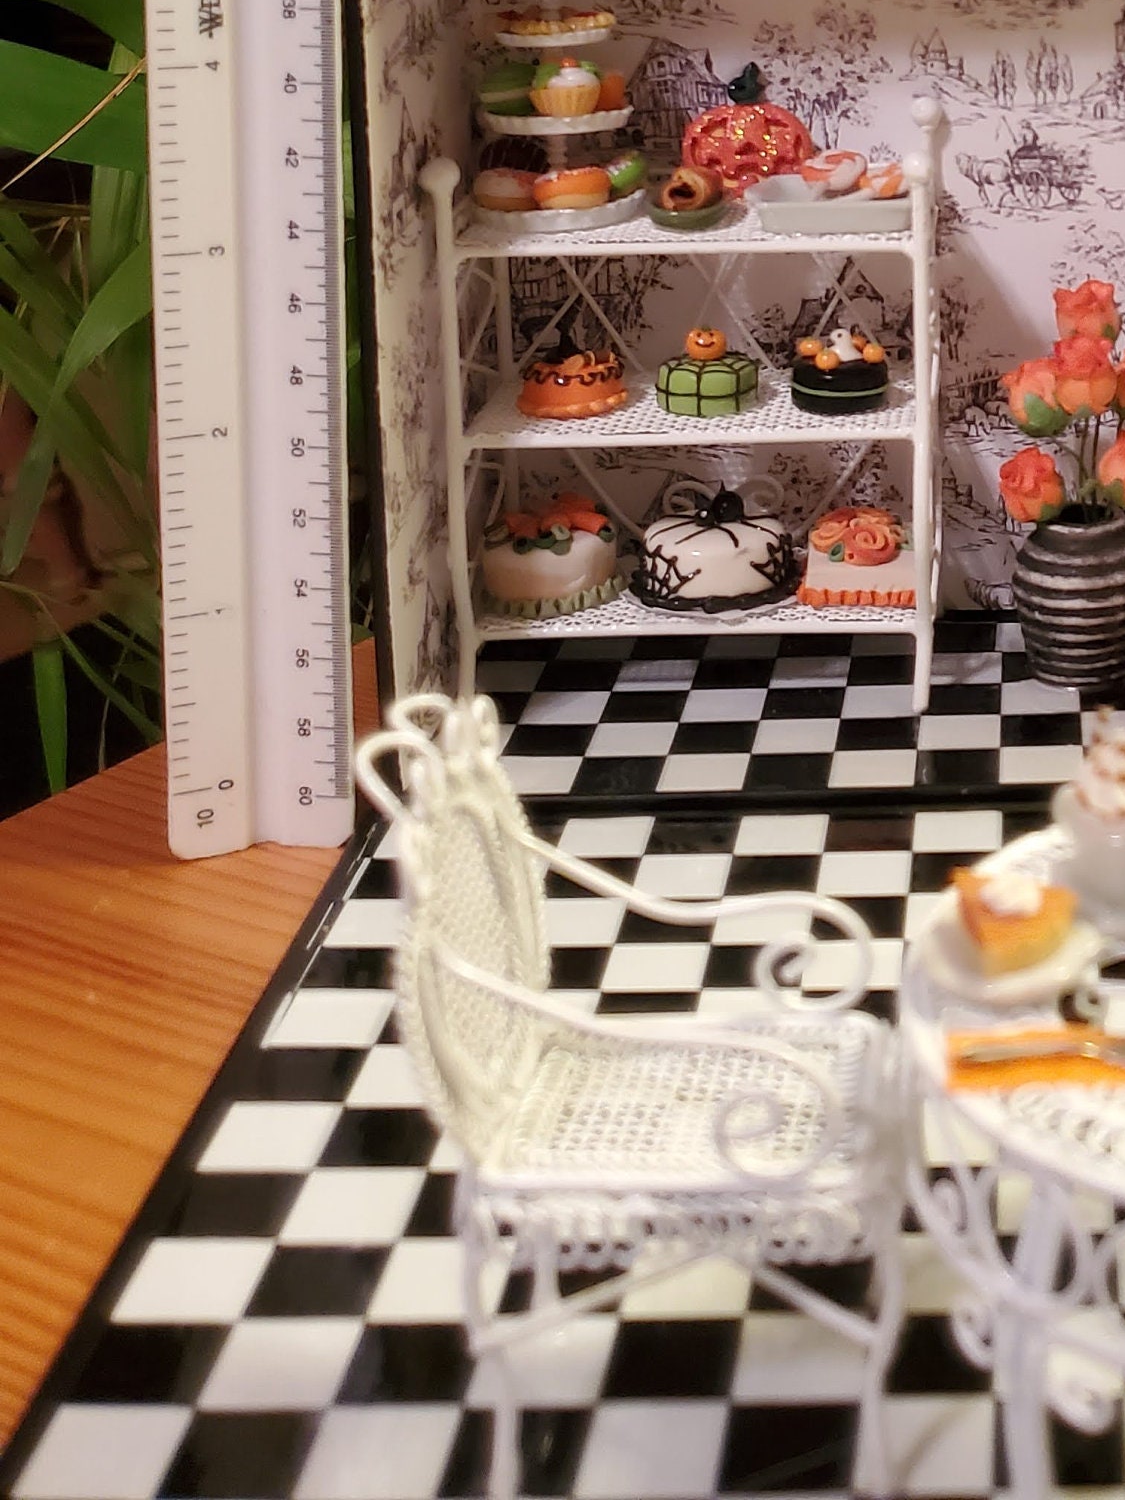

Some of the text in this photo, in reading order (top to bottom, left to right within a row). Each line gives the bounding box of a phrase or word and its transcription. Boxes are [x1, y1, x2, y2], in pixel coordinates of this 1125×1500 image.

[282, 0, 297, 20] 38
[204, 60, 221, 72] 4
[283, 72, 298, 94] 40
[285, 146, 299, 169] 42
[287, 219, 300, 240] 44
[208, 245, 226, 257] 3
[288, 292, 302, 314] 46
[289, 365, 304, 386] 48
[211, 427, 228, 438] 2
[290, 437, 305, 458] 50
[292, 508, 307, 529] 52
[293, 579, 308, 598] 54
[295, 648, 310, 668] 56
[297, 717, 312, 737] 58
[217, 779, 235, 791] 0
[298, 786, 313, 806] 60
[196, 808, 215, 829] 10
